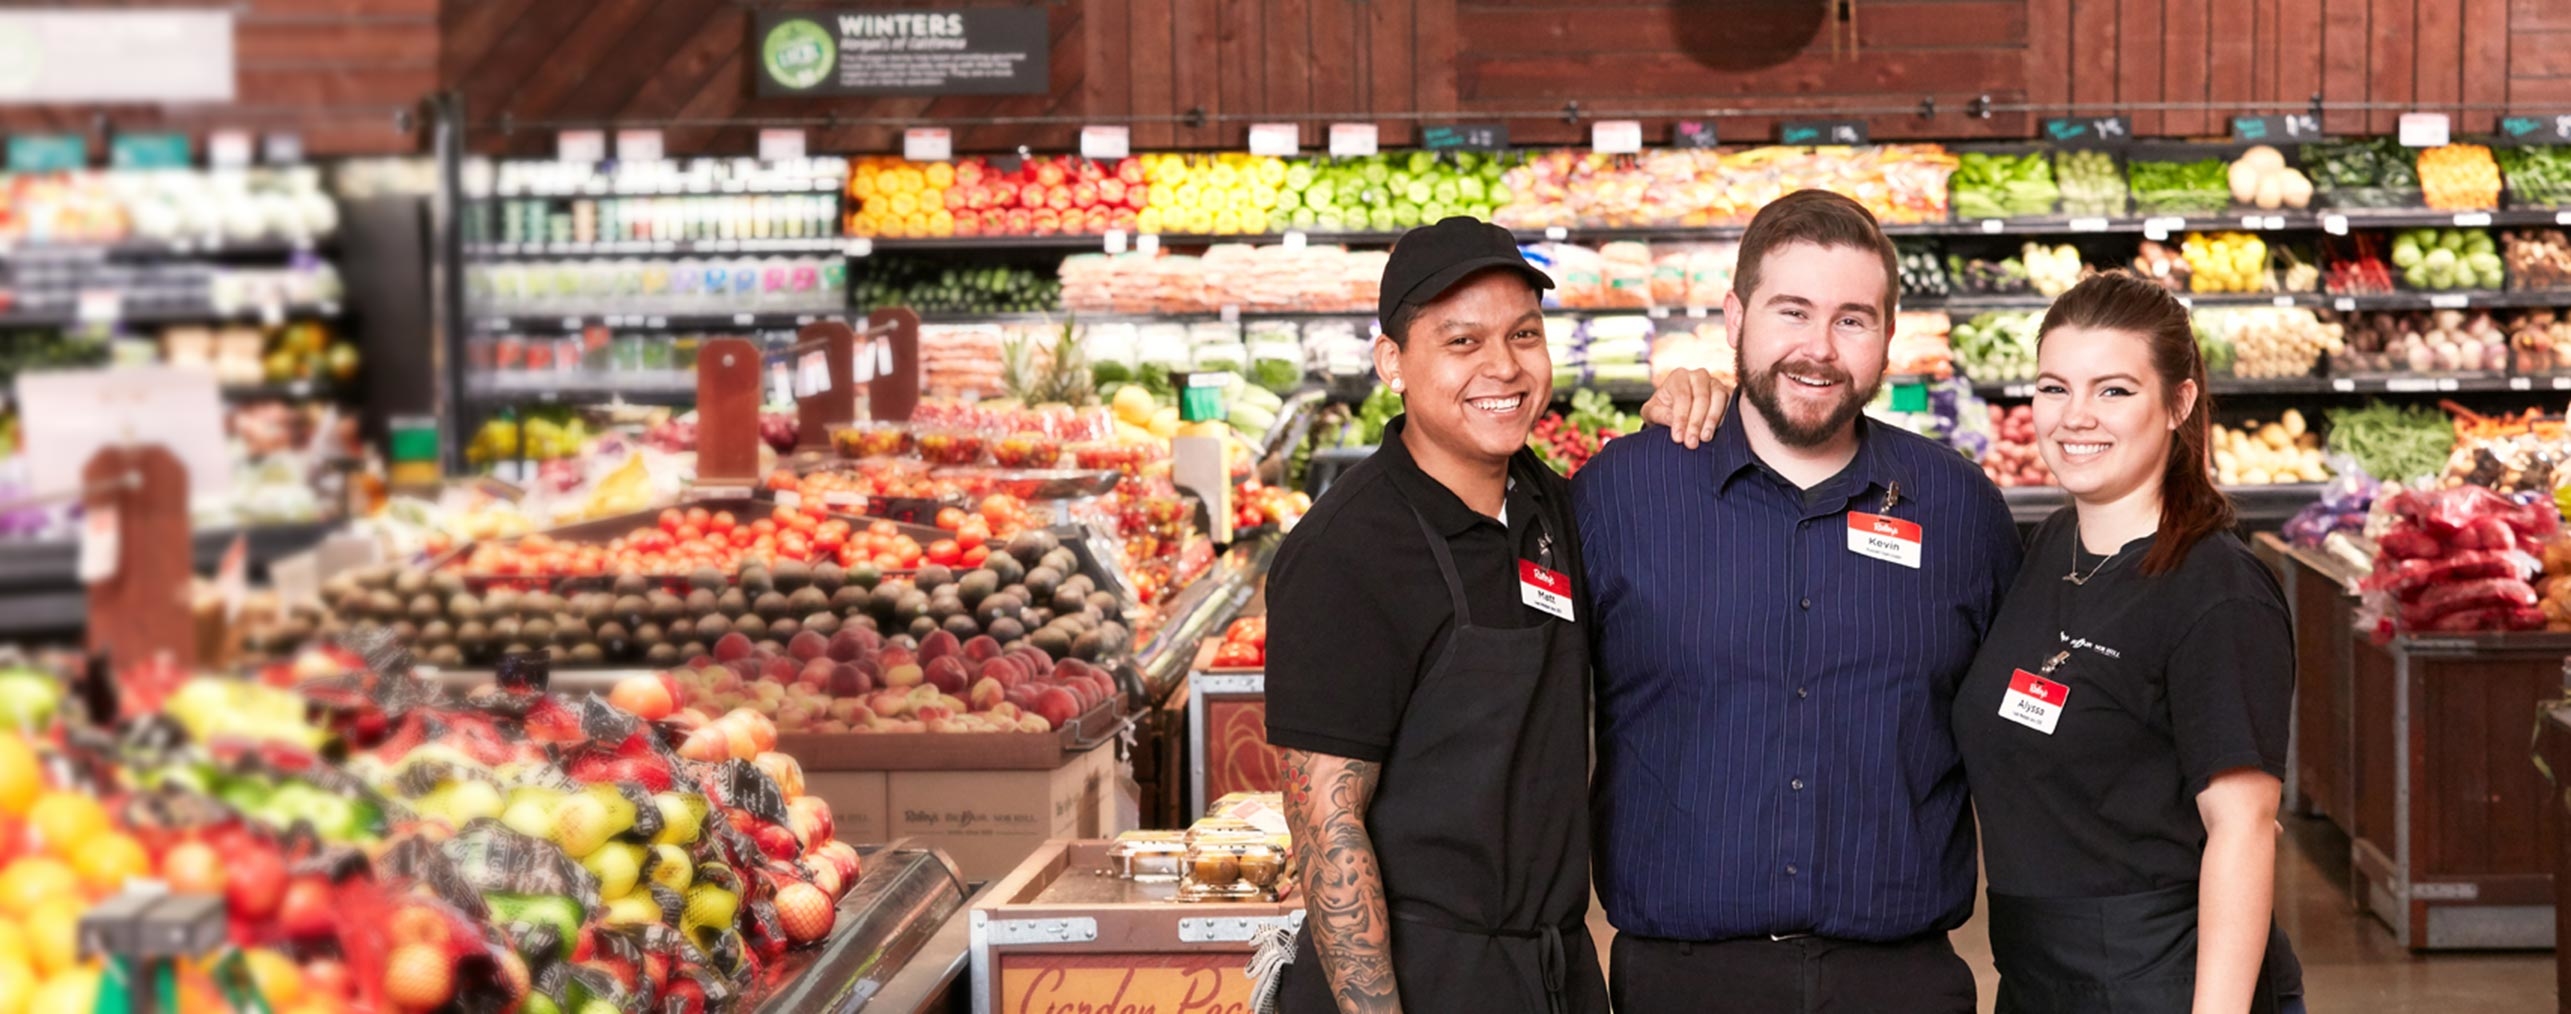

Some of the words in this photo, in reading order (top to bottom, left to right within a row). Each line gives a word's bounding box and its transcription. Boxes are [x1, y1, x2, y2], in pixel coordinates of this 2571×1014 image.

[838, 13, 964, 37] WINTERS
[1868, 537, 1900, 551] Kevin
[2017, 699, 2045, 716] Alyssa
